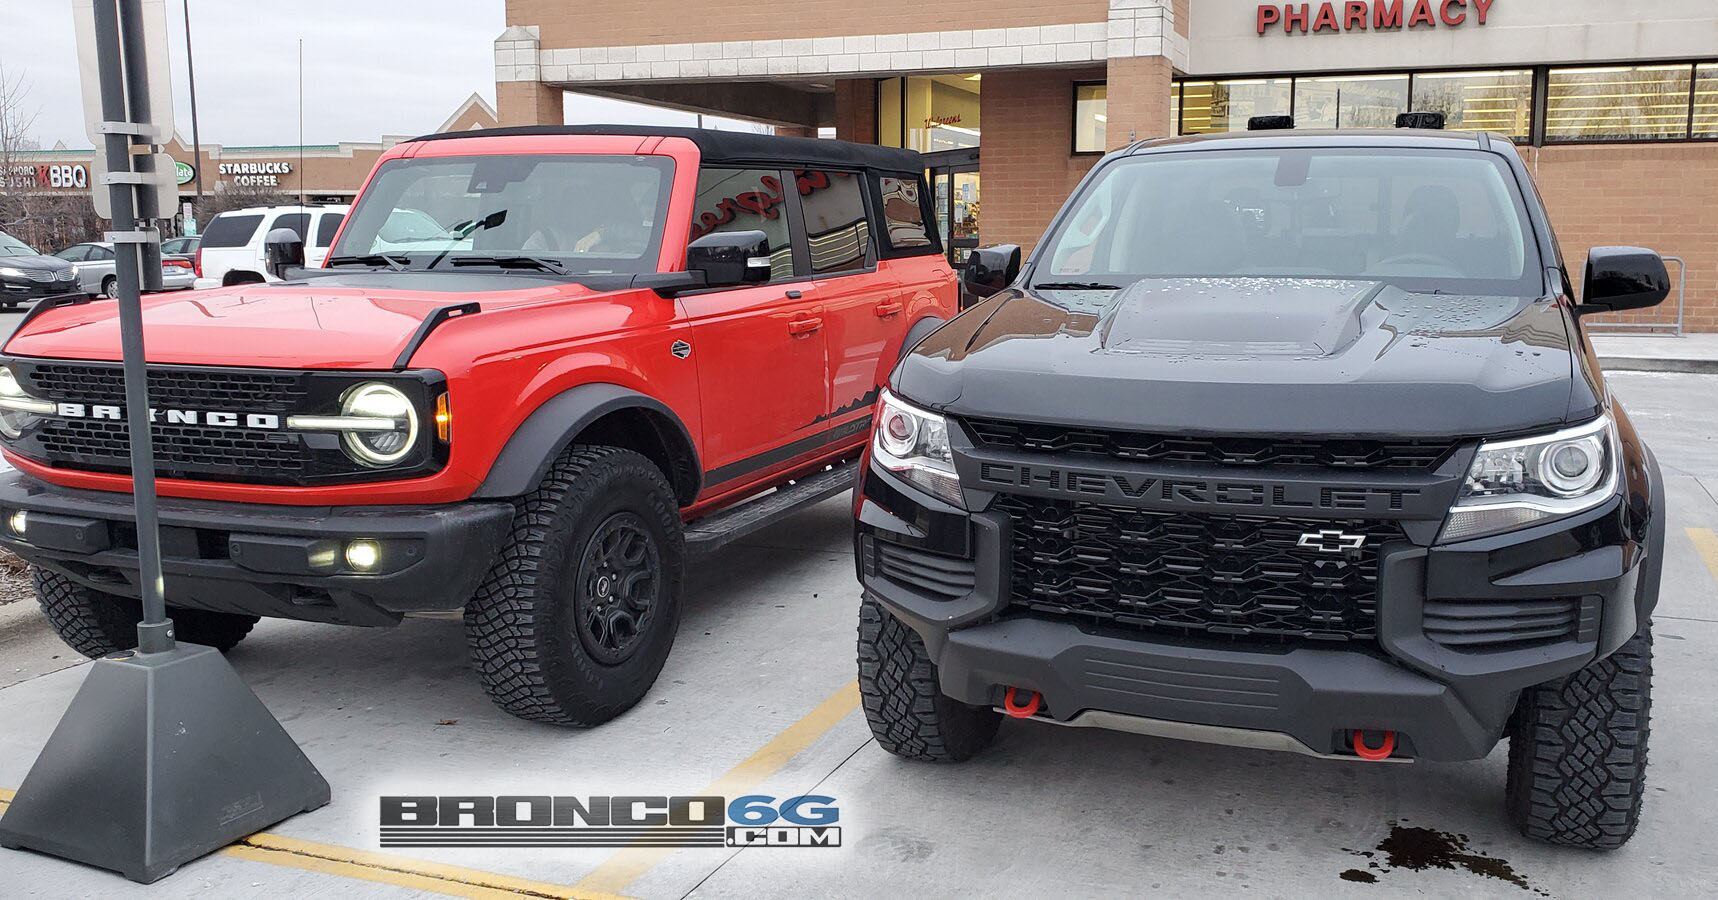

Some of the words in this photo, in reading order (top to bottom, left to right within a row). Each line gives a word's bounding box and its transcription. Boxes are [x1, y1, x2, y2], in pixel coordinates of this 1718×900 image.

[1256, 0, 1494, 34] PHARMACY
[218, 162, 290, 175] STARBUCKS
[234, 175, 278, 187] COFFEE
[57, 402, 279, 429] BRNCO
[980, 461, 1422, 511] CHEVROLET
